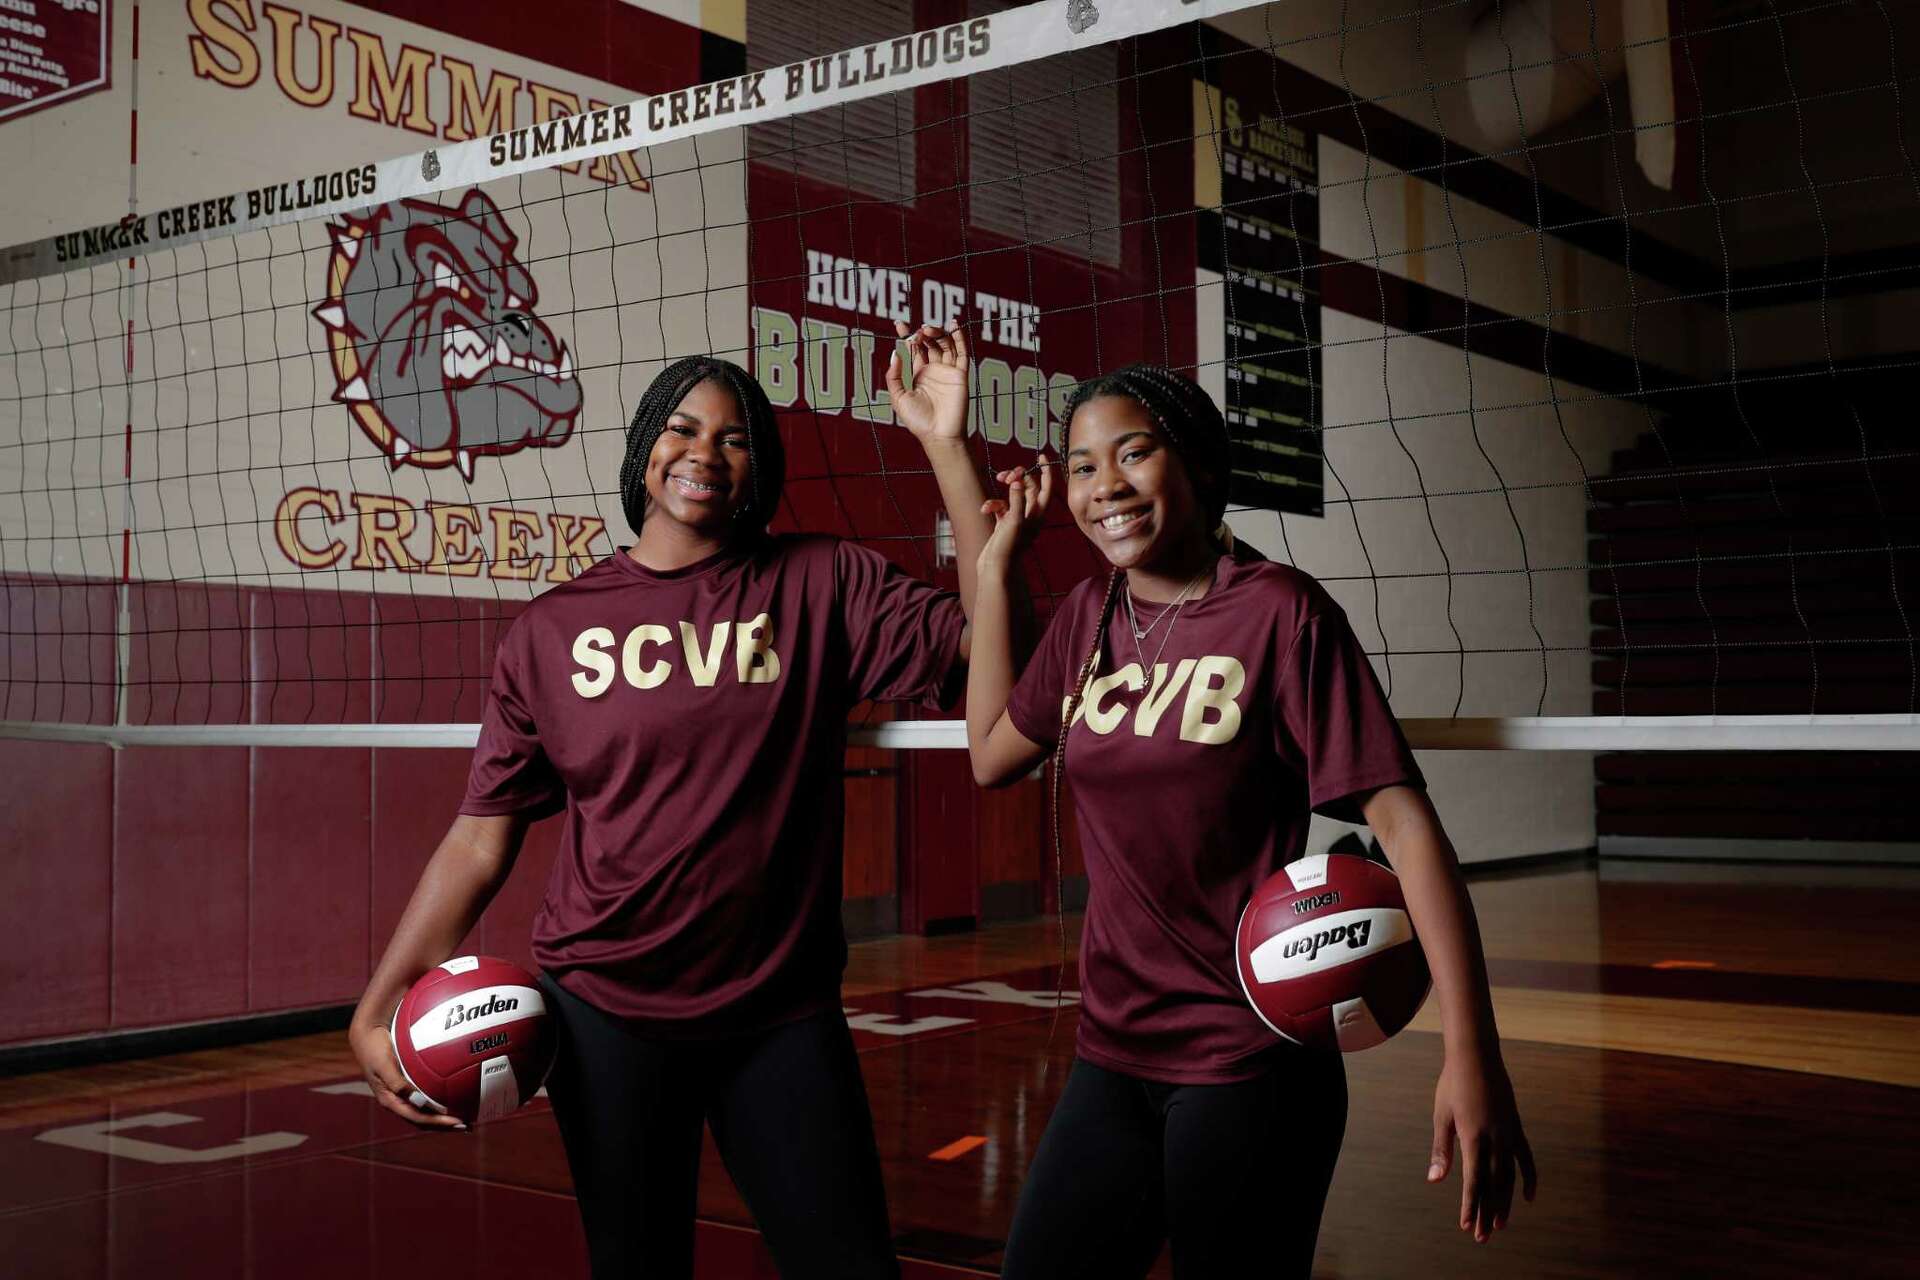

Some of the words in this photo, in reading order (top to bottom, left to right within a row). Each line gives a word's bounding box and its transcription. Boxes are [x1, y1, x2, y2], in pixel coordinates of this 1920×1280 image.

[490, 105, 632, 167] SUMMER
[647, 74, 767, 132] CREEK
[785, 18, 991, 102] BULLDOGS
[157, 195, 237, 240] CREEK
[247, 164, 377, 220] BULLDOGS
[806, 250, 911, 324] HOME
[922, 279, 965, 332] OF
[975, 291, 1041, 352] THE
[274, 486, 605, 583] CREEK
[571, 613, 781, 699] SCVB
[1283, 918, 1372, 961] Baden
[1293, 890, 1342, 915] LEXUM
[445, 994, 519, 1031] Baden
[470, 1032, 511, 1054] LEXUM
